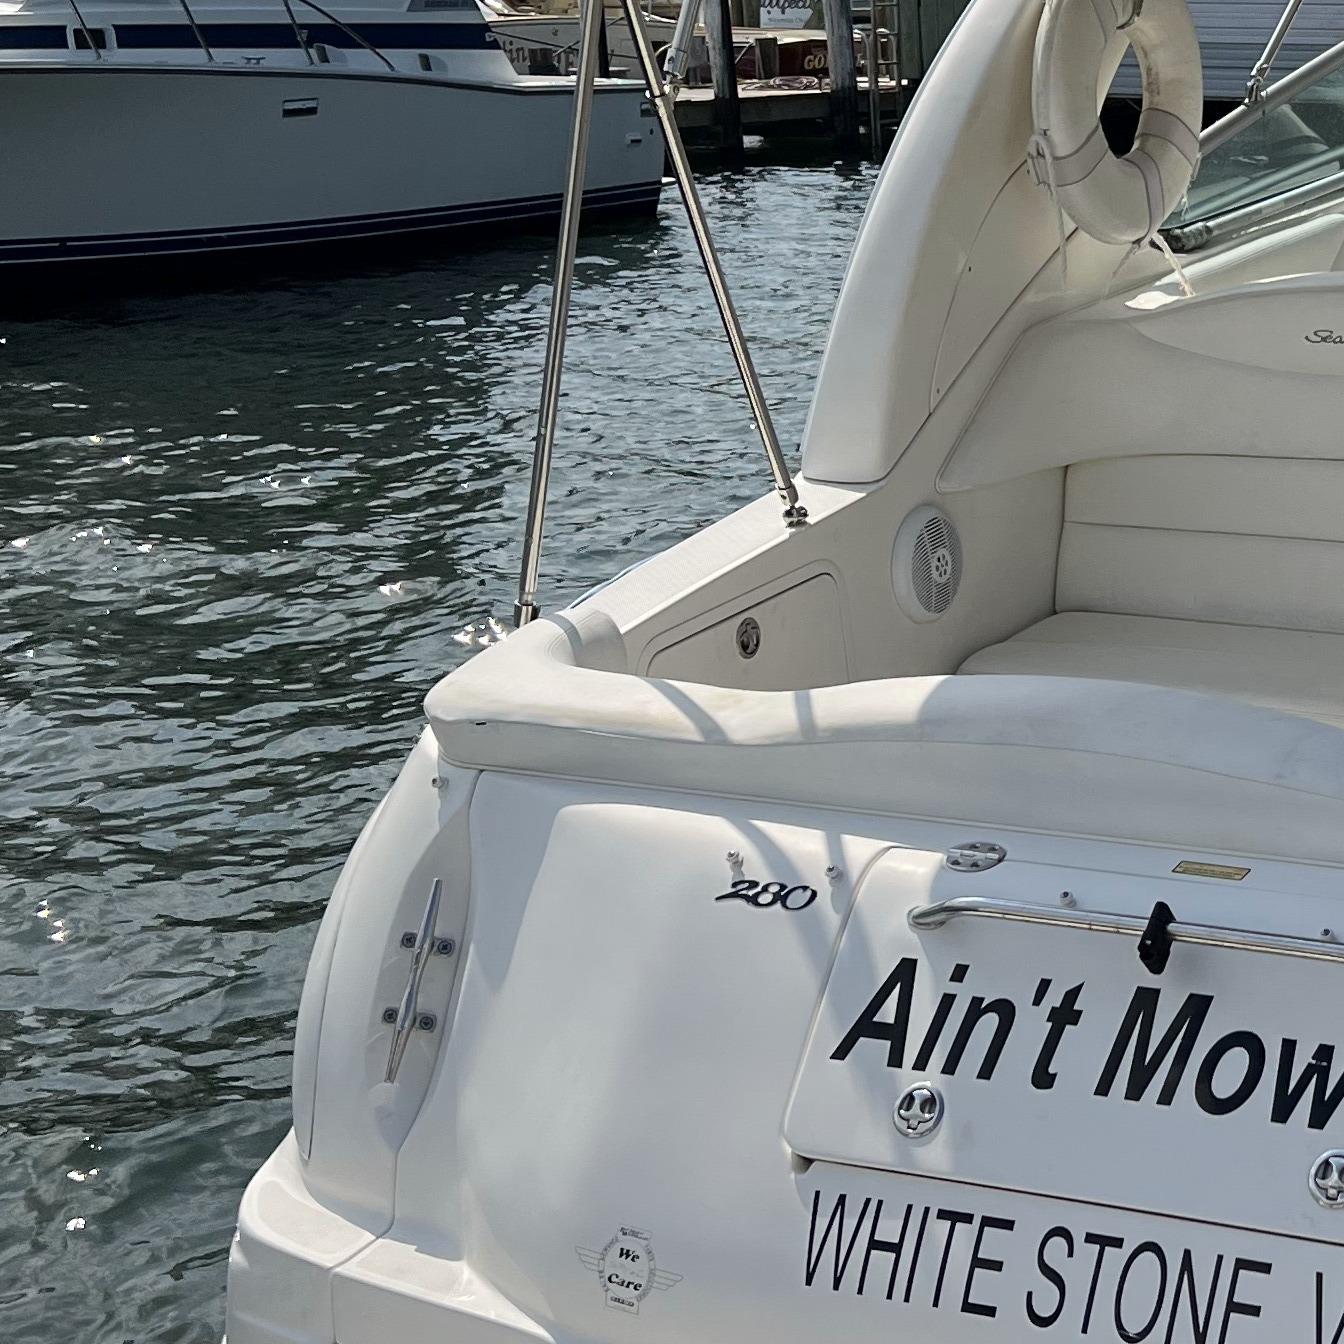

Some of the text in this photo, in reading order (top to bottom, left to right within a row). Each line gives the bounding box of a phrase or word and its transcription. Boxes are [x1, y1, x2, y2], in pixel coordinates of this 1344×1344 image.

[715, 879, 818, 911] 280
[829, 957, 1085, 1090] Ain't
[619, 1247, 640, 1262] We
[804, 1189, 1016, 1319] WHITE
[607, 1272, 643, 1291] Care
